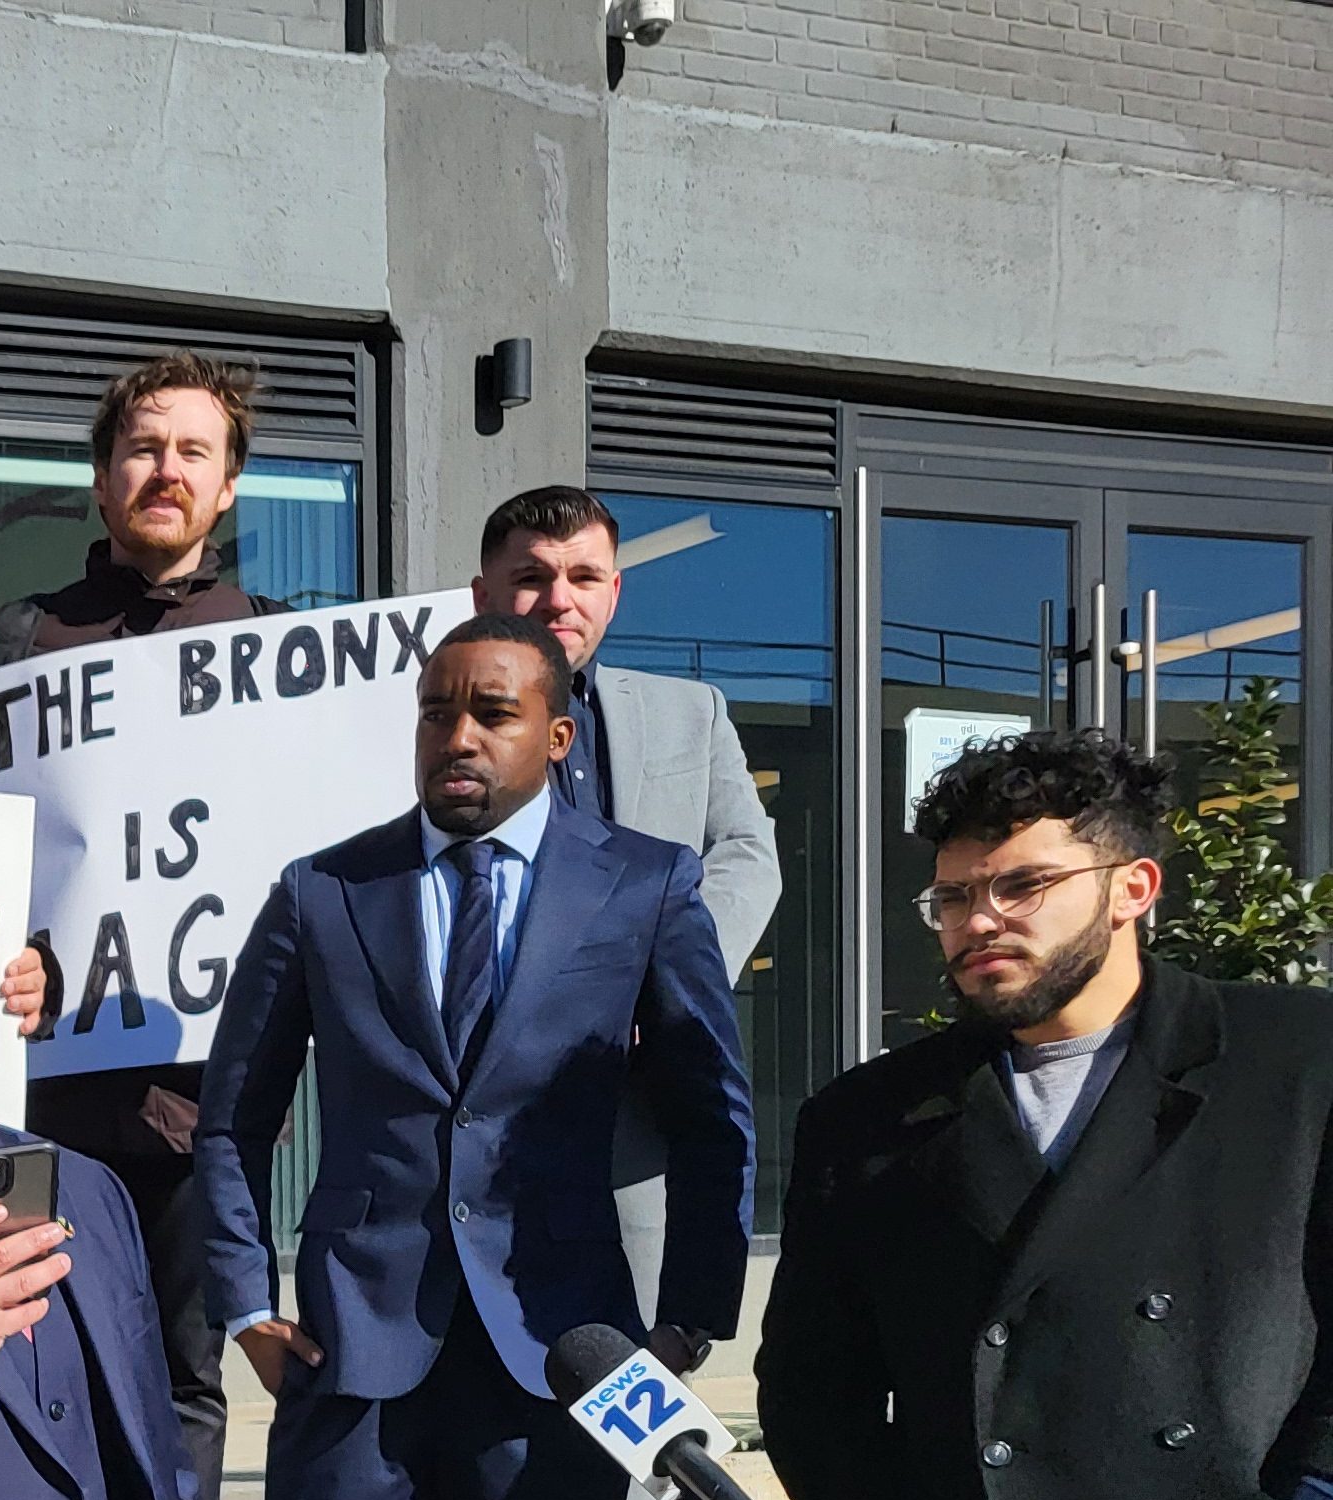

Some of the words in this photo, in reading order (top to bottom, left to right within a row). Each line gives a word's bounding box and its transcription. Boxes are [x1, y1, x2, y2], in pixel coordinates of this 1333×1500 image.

[178, 607, 432, 717] BRONX
[124, 798, 210, 882] IS
[582, 1360, 648, 1418] news
[599, 1378, 687, 1447] 12
